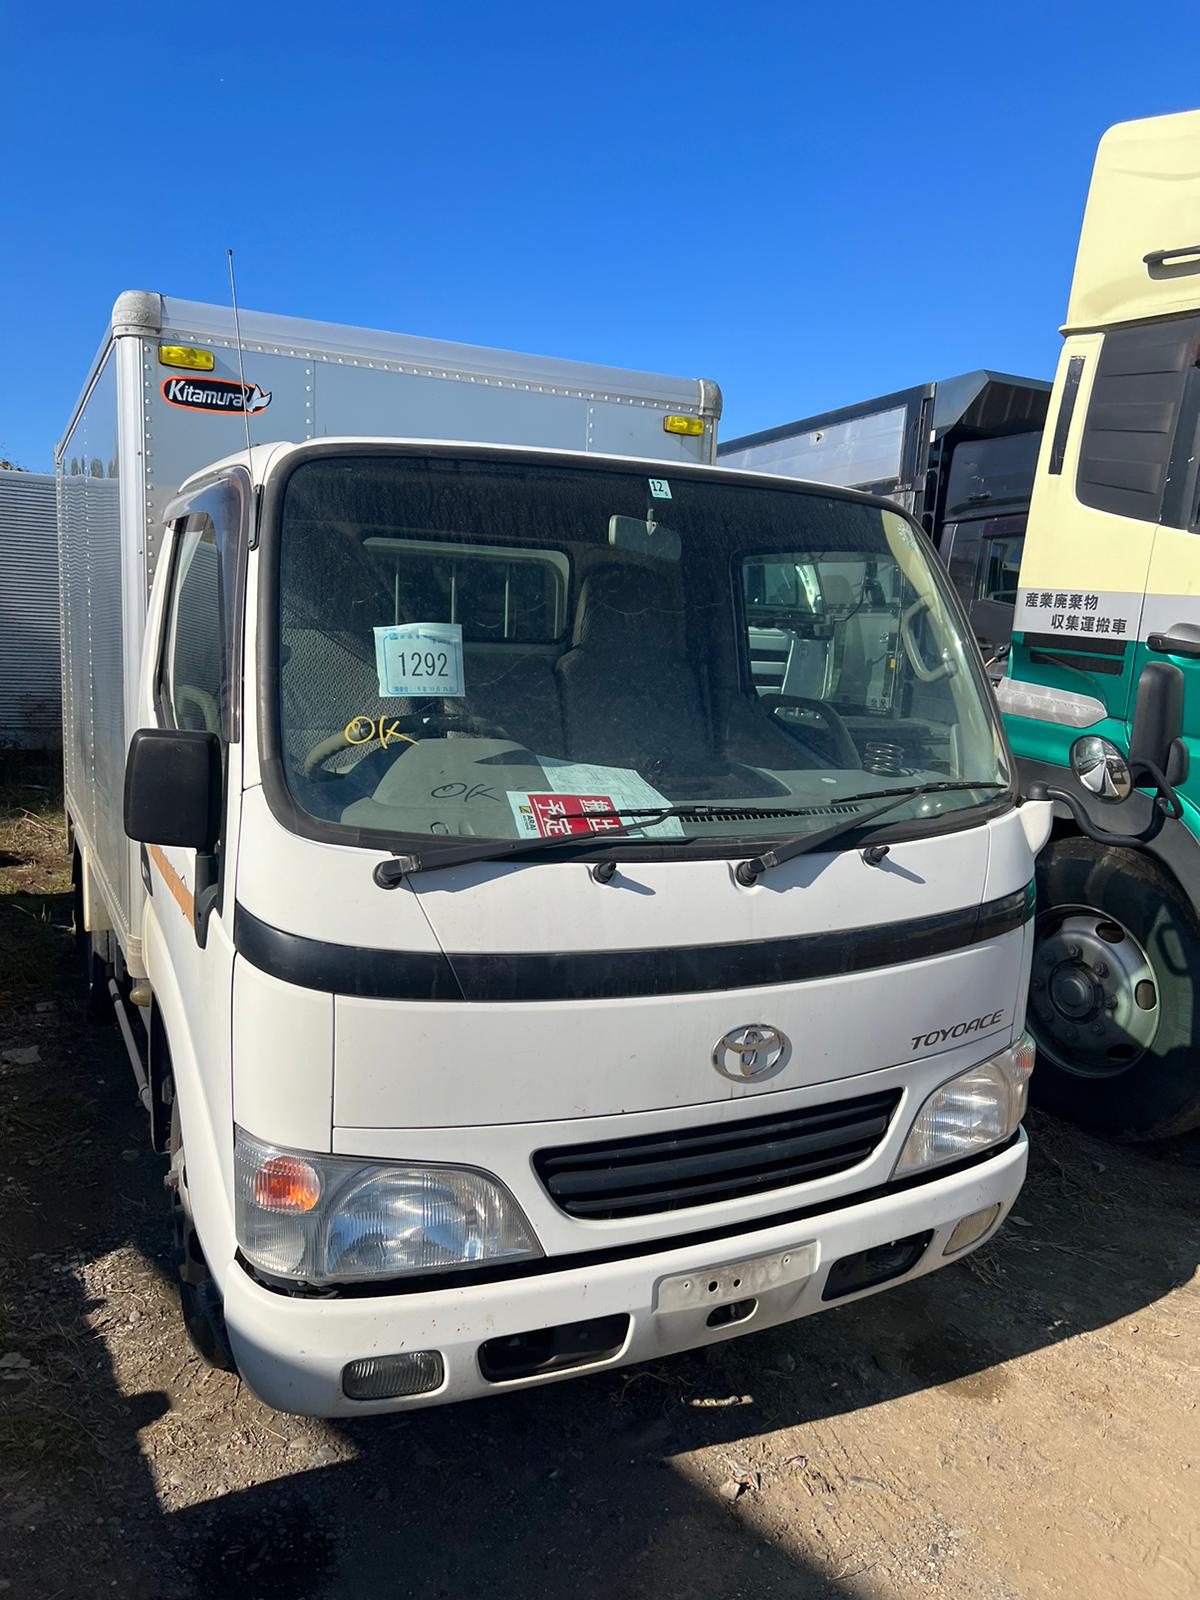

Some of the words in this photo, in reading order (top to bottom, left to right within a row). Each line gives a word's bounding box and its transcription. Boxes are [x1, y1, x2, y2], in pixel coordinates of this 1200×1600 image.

[168, 380, 243, 407] Kitamura
[652, 481, 664, 491] 12
[1025, 592, 1099, 611] 産業廃棄物
[1050, 613, 1127, 635] 収集運搬車
[398, 651, 449, 677] 1292
[344, 715, 420, 750] OK
[431, 782, 500, 802] OK
[538, 799, 573, 836] 予定
[911, 1009, 1004, 1050] TOYOACE
